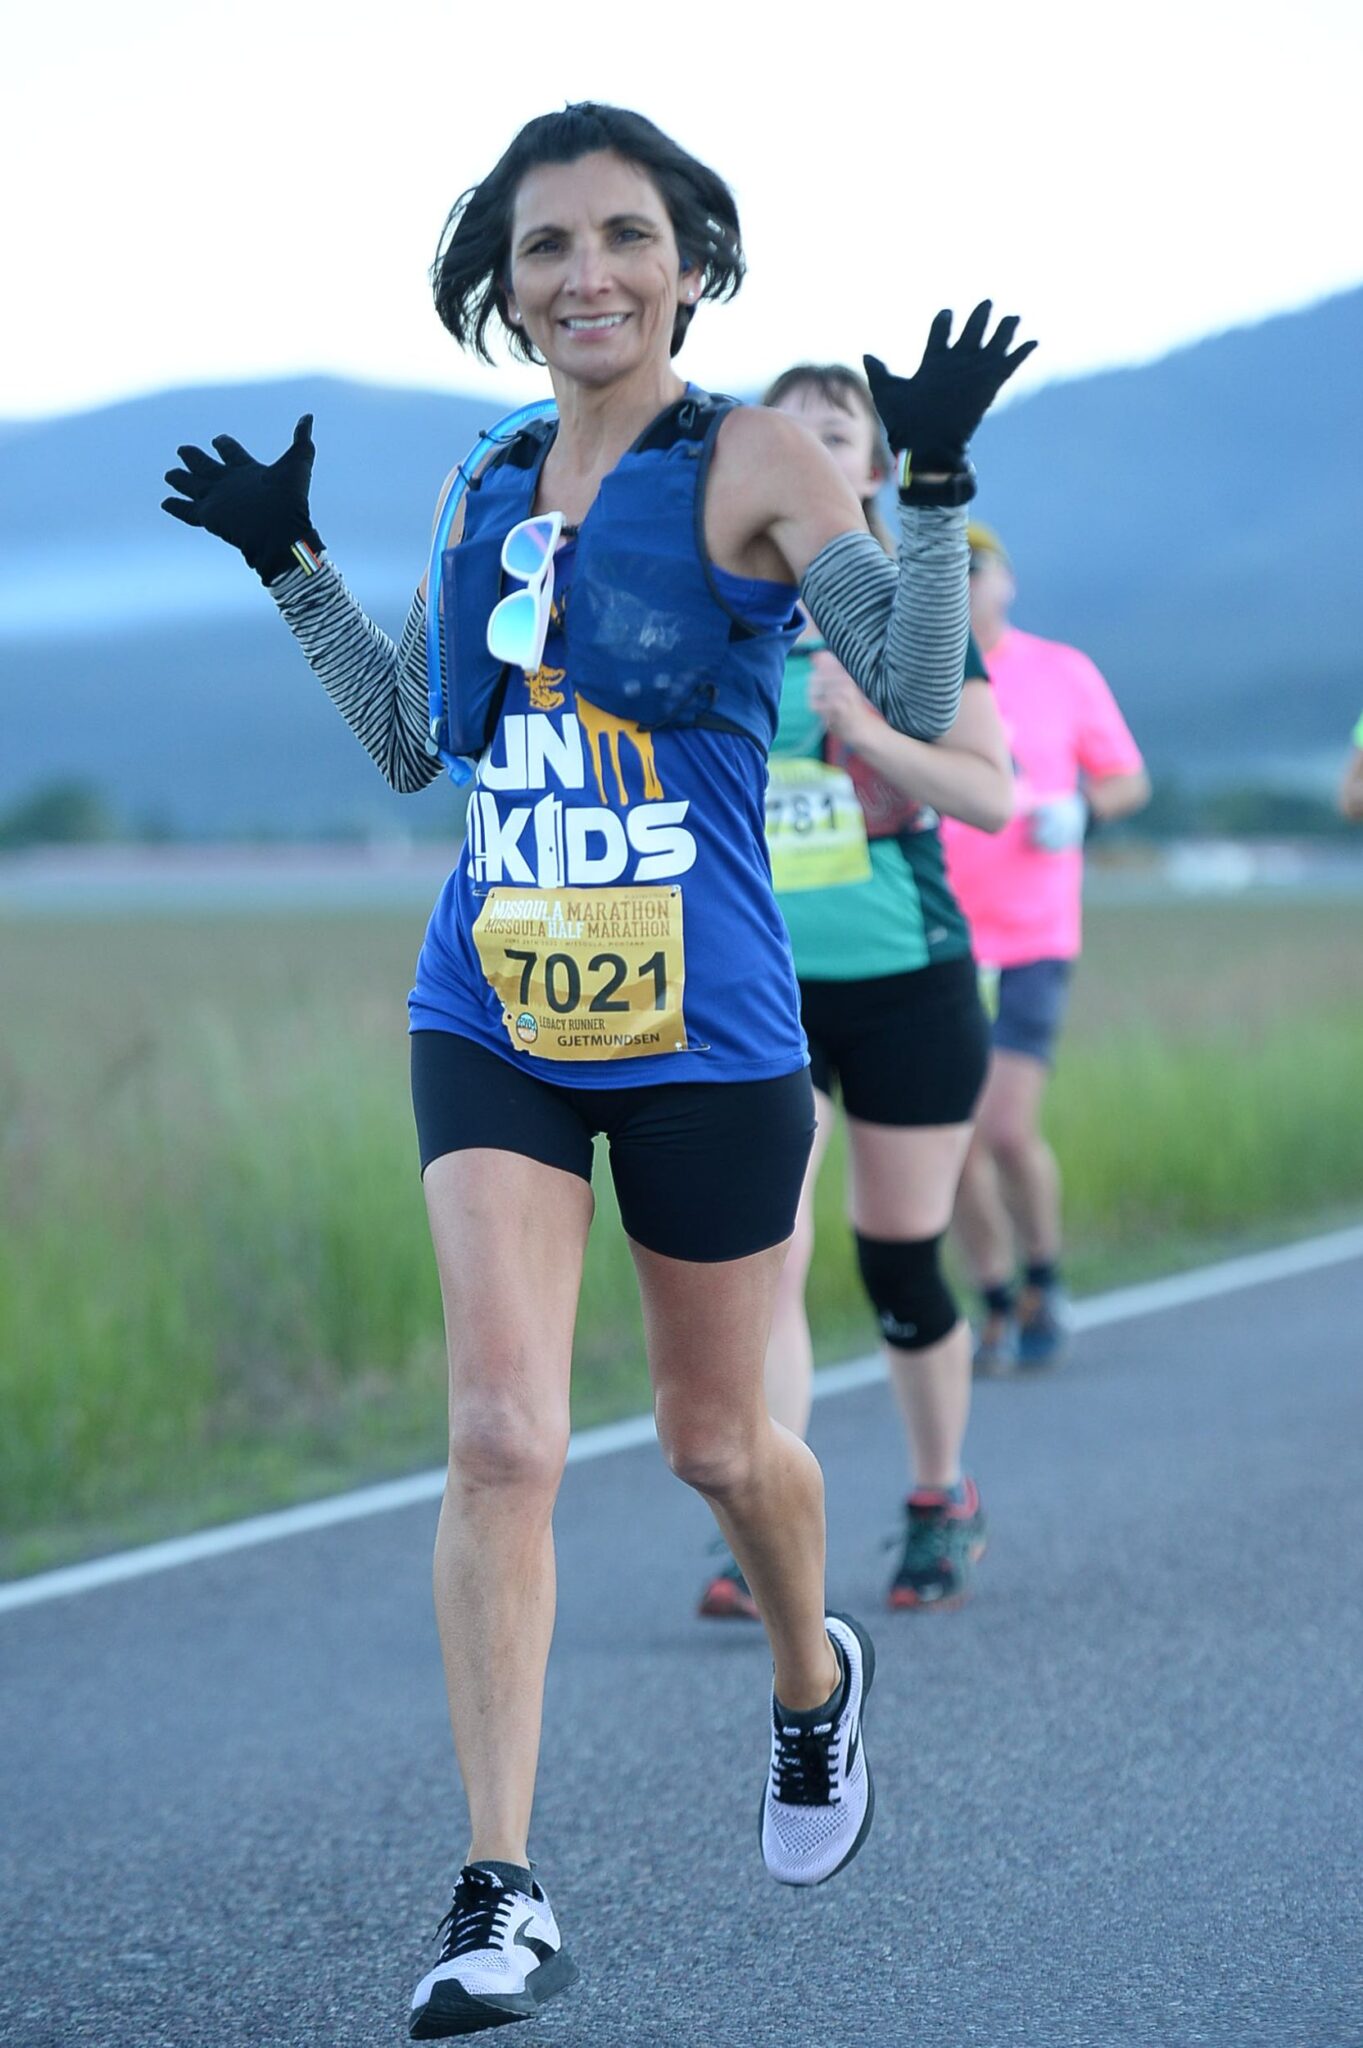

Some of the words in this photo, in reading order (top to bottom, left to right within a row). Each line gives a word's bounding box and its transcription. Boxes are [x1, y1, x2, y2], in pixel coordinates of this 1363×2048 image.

[489, 900, 564, 921] MISSOULA
[567, 900, 669, 922] MARATHON
[484, 919, 546, 937] MISSOULA
[547, 919, 584, 939] HALF
[587, 920, 670, 939] MARATHON
[504, 949, 668, 1014] 7021
[539, 1016, 567, 1031] LEGACY
[568, 1018, 606, 1031] RUNNER
[557, 1032, 660, 1047] GJETMUNDSEN
